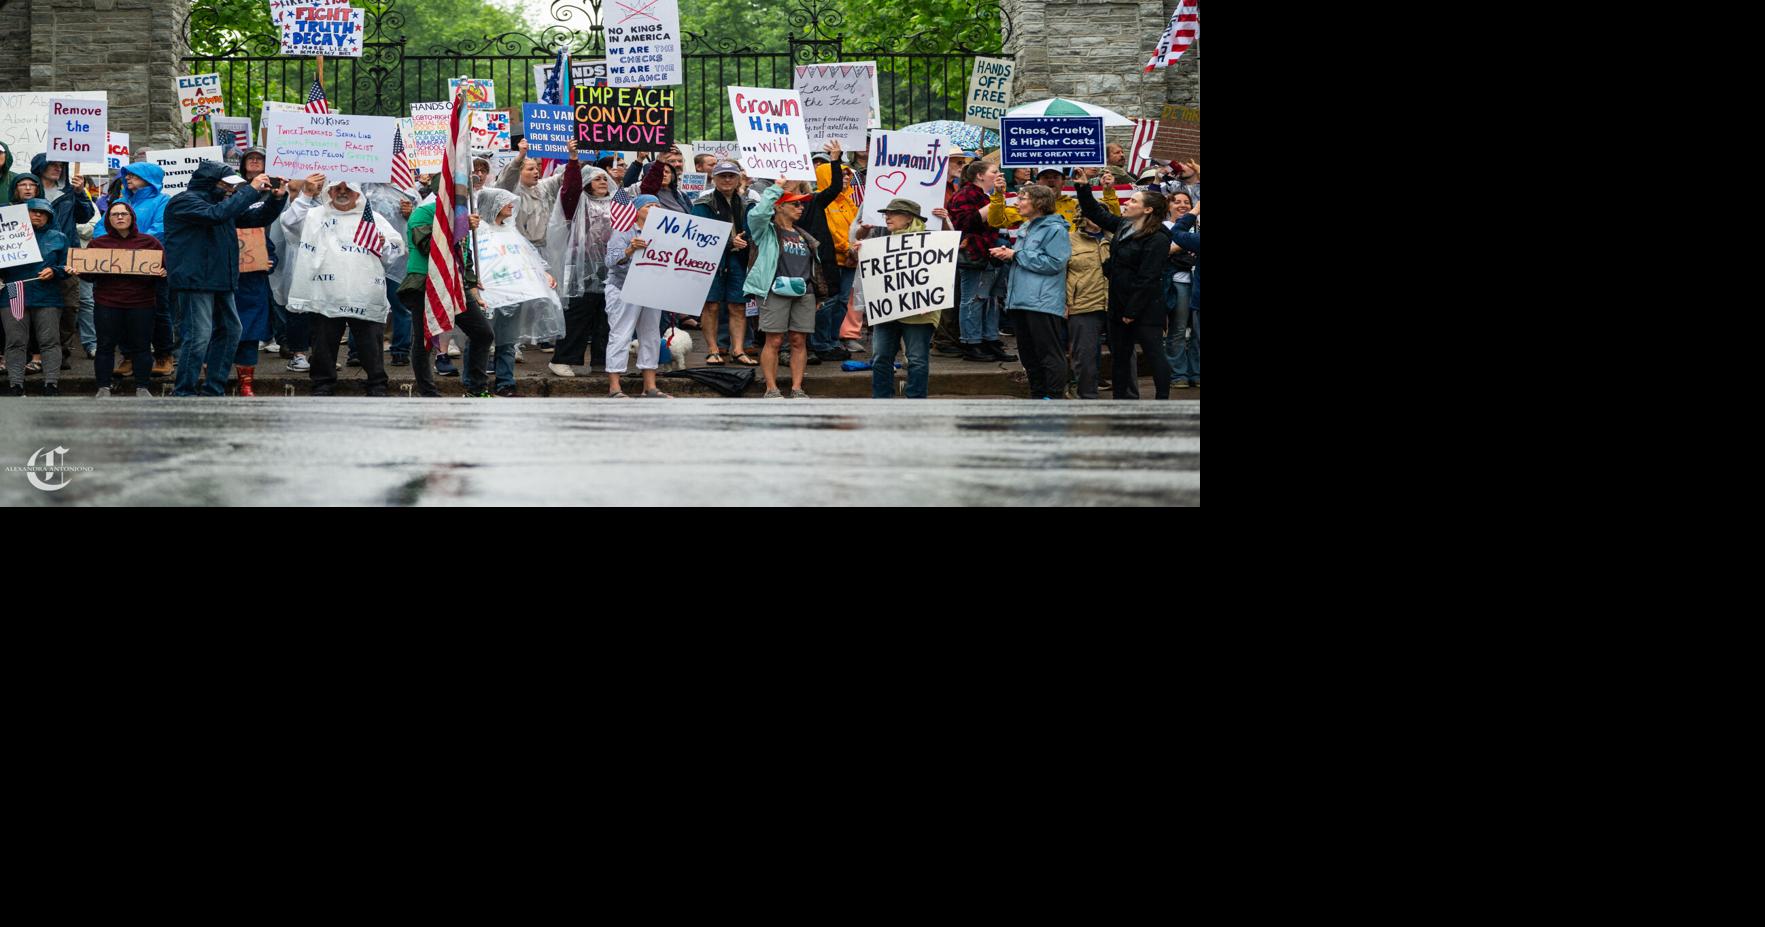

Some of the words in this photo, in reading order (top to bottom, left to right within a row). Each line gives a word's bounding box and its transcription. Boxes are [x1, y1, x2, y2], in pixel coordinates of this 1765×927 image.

[295, 7, 353, 21] FIGHT
[295, 21, 354, 33] TRUTH
[608, 27, 623, 35] NO
[630, 24, 663, 33] KINGS
[292, 32, 347, 46] DECAY
[609, 35, 619, 43] IN
[624, 33, 671, 42] AMERICA
[609, 47, 624, 55] WE
[629, 46, 649, 54] ARE
[654, 44, 674, 53] THE
[620, 54, 663, 63] CHECKS
[610, 66, 625, 74] WE
[629, 65, 650, 73] ARE
[655, 64, 675, 72] THE
[977, 60, 1011, 77] HANDS
[179, 75, 218, 88] ELECT
[614, 73, 668, 84] BALANCE
[978, 75, 1007, 89] OFF
[195, 87, 204, 97] A
[800, 80, 839, 95] Land
[843, 80, 858, 94] of
[181, 95, 223, 107] CLOWN
[575, 85, 674, 107] IMPEACH
[804, 97, 823, 107] the
[973, 89, 1006, 104] FREE
[54, 102, 102, 116] Remove
[410, 102, 444, 111] HANDS
[736, 93, 800, 117] Crown
[531, 110, 550, 119] J.D.
[553, 110, 575, 121] VAN
[575, 105, 673, 125] CONVICT
[967, 105, 1007, 120] SPEECH
[66, 120, 90, 132] the
[310, 116, 325, 125] NO
[325, 116, 350, 126] KINGS
[530, 122, 550, 131] PUTS
[553, 123, 566, 131] HIS
[748, 115, 789, 135] Him
[5, 127, 47, 146] SAV
[578, 123, 666, 145] REMOVE
[813, 131, 824, 139] all
[1010, 127, 1049, 136] Chaos,
[1051, 126, 1094, 136] Cruelty
[530, 133, 548, 141] IRON
[550, 134, 575, 143] SKILLE
[1010, 138, 1018, 146] &
[1020, 138, 1060, 147] Higher
[1062, 137, 1096, 145] Costs
[53, 137, 90, 152] Felon
[697, 143, 725, 152] Hands
[156, 158, 177, 166] The
[874, 134, 948, 187] Humanity
[163, 168, 194, 177] hrone
[161, 181, 189, 189] eeds
[9, 232, 26, 240] OUR
[656, 215, 680, 234] No
[681, 219, 720, 248] Kings
[886, 232, 931, 253] LET
[0, 250, 28, 264] ING
[783, 246, 806, 256] VOTE
[71, 248, 122, 273] Fuck
[126, 250, 161, 274] Ice
[674, 247, 717, 270] Queens
[860, 247, 954, 278] FREEDOM
[884, 267, 930, 293] RING
[868, 298, 893, 320] NO
[898, 286, 945, 313] KING
